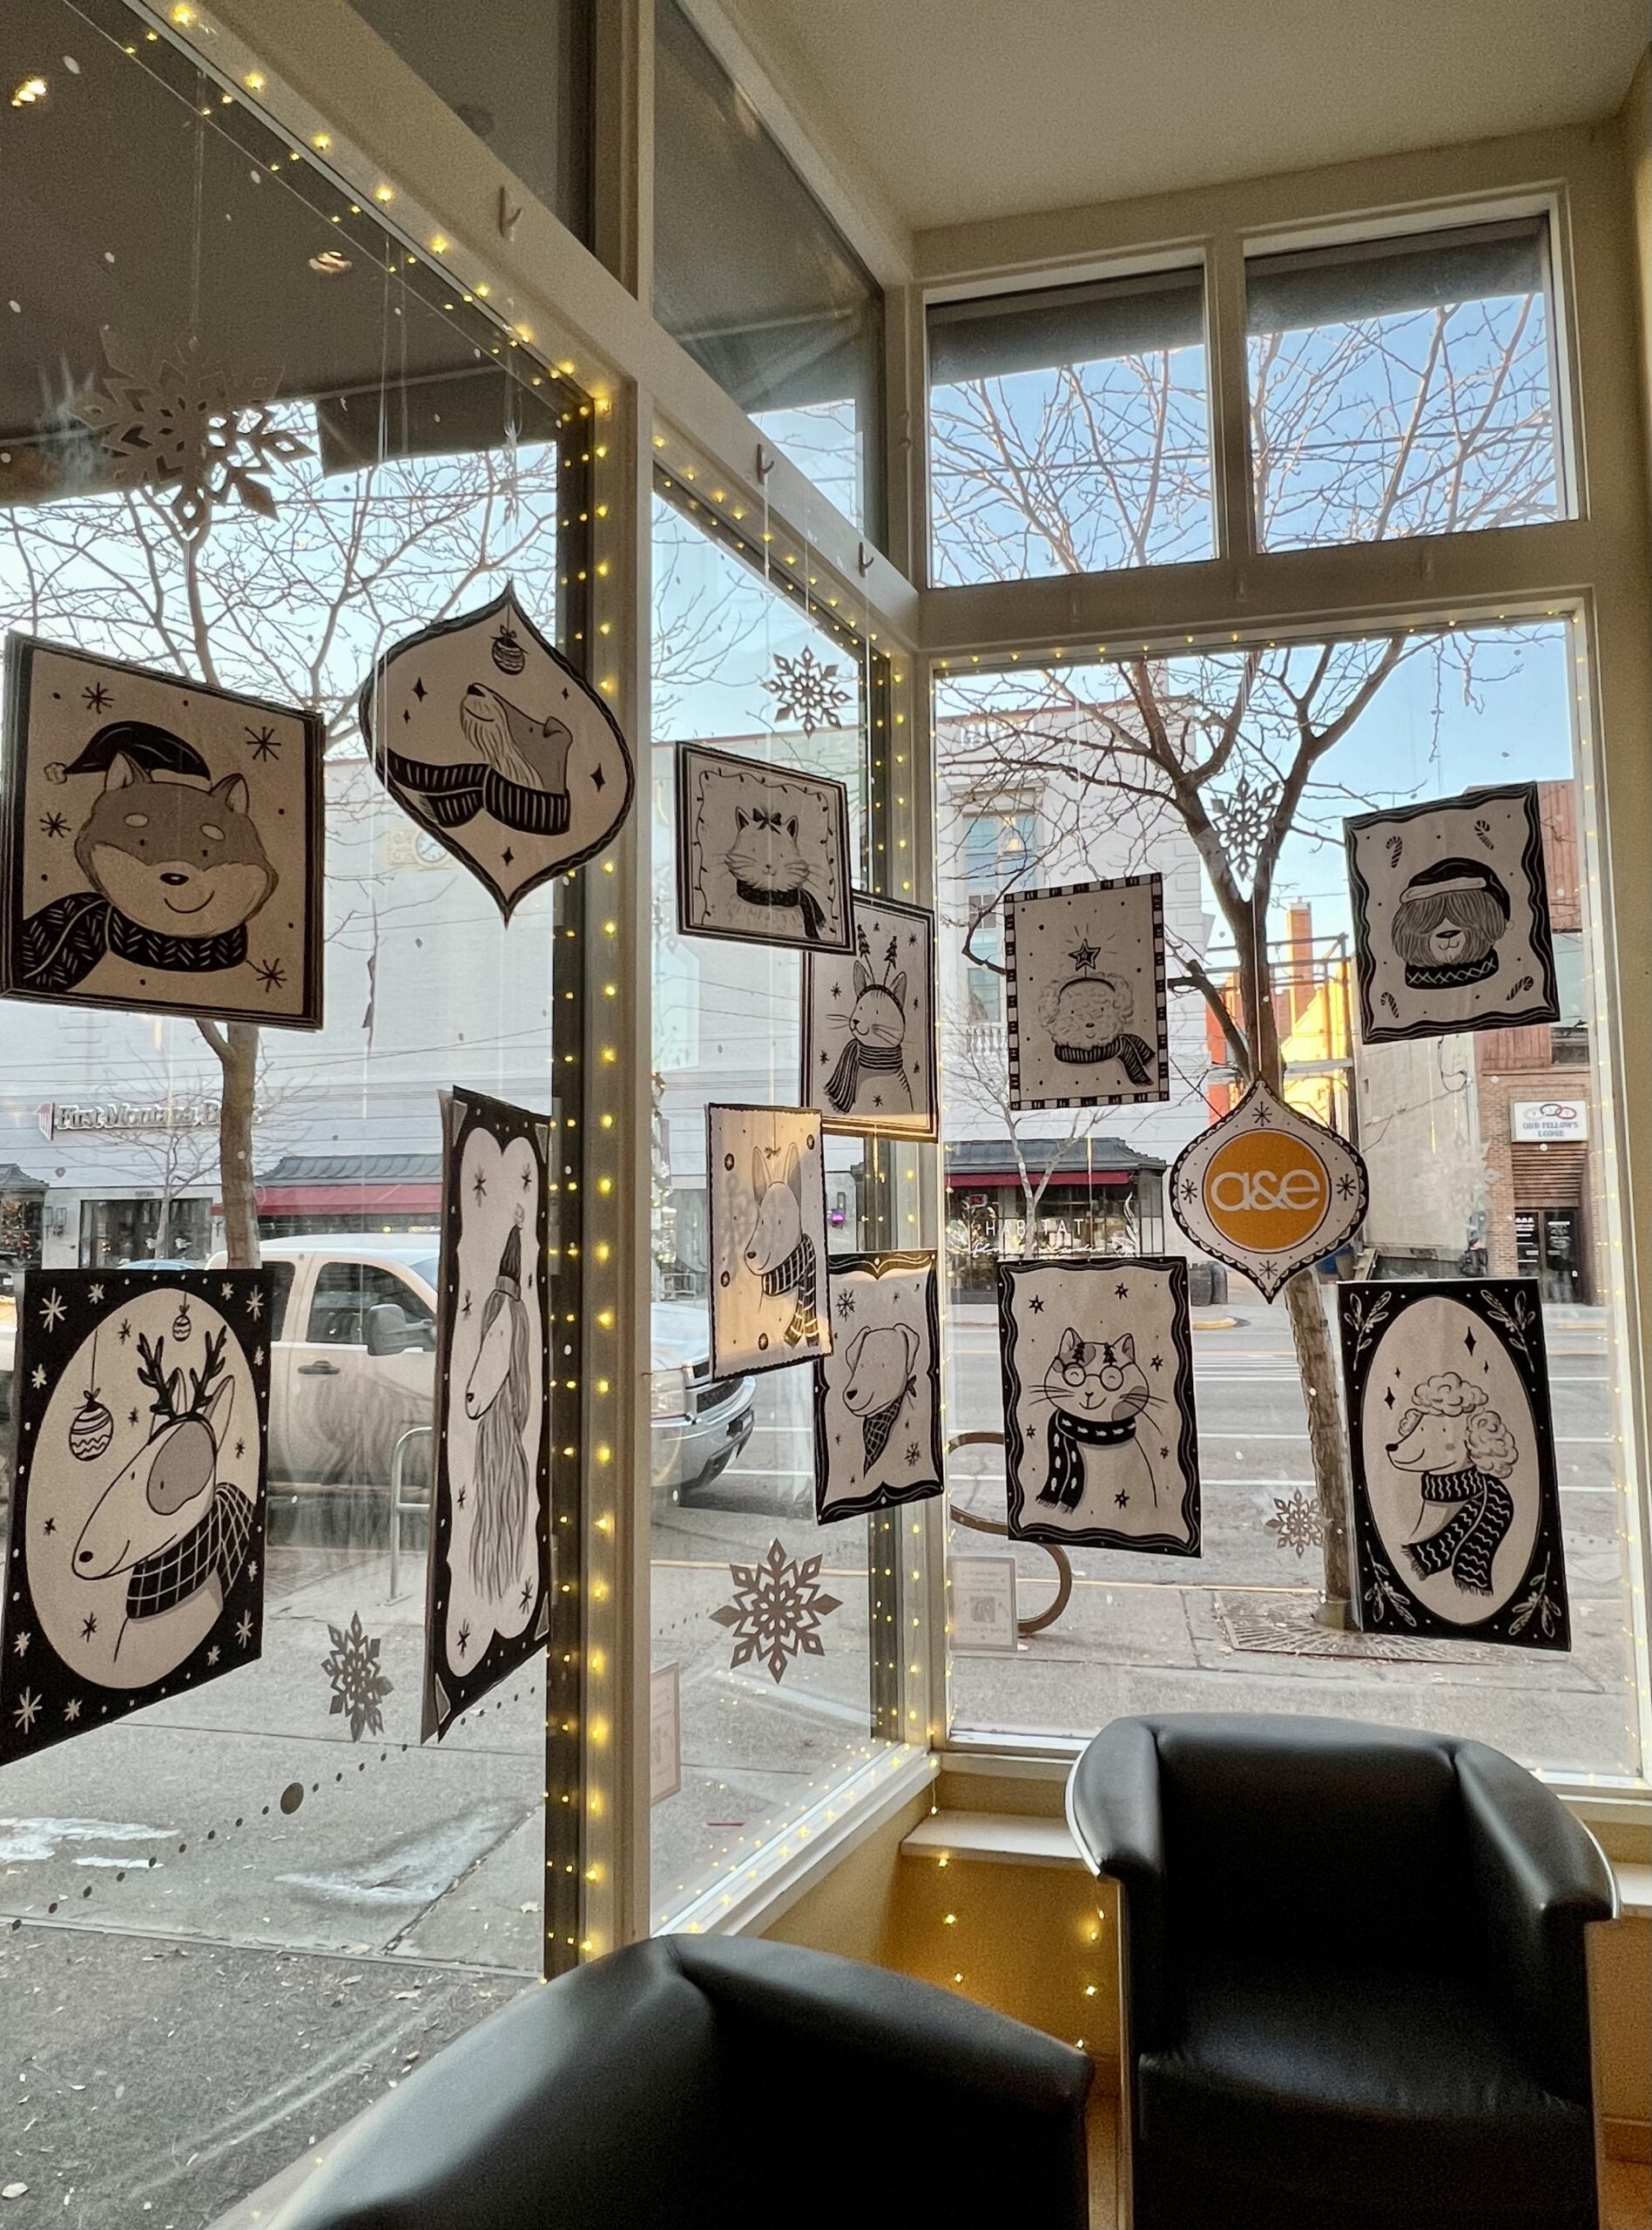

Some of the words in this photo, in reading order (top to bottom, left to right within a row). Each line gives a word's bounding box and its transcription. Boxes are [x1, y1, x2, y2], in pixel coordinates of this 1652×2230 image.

[57, 1104, 104, 1129] First
[105, 1102, 199, 1128] Montana
[1210, 1169, 1321, 1212] a&e
[986, 1218, 1085, 1237] HABTAT
